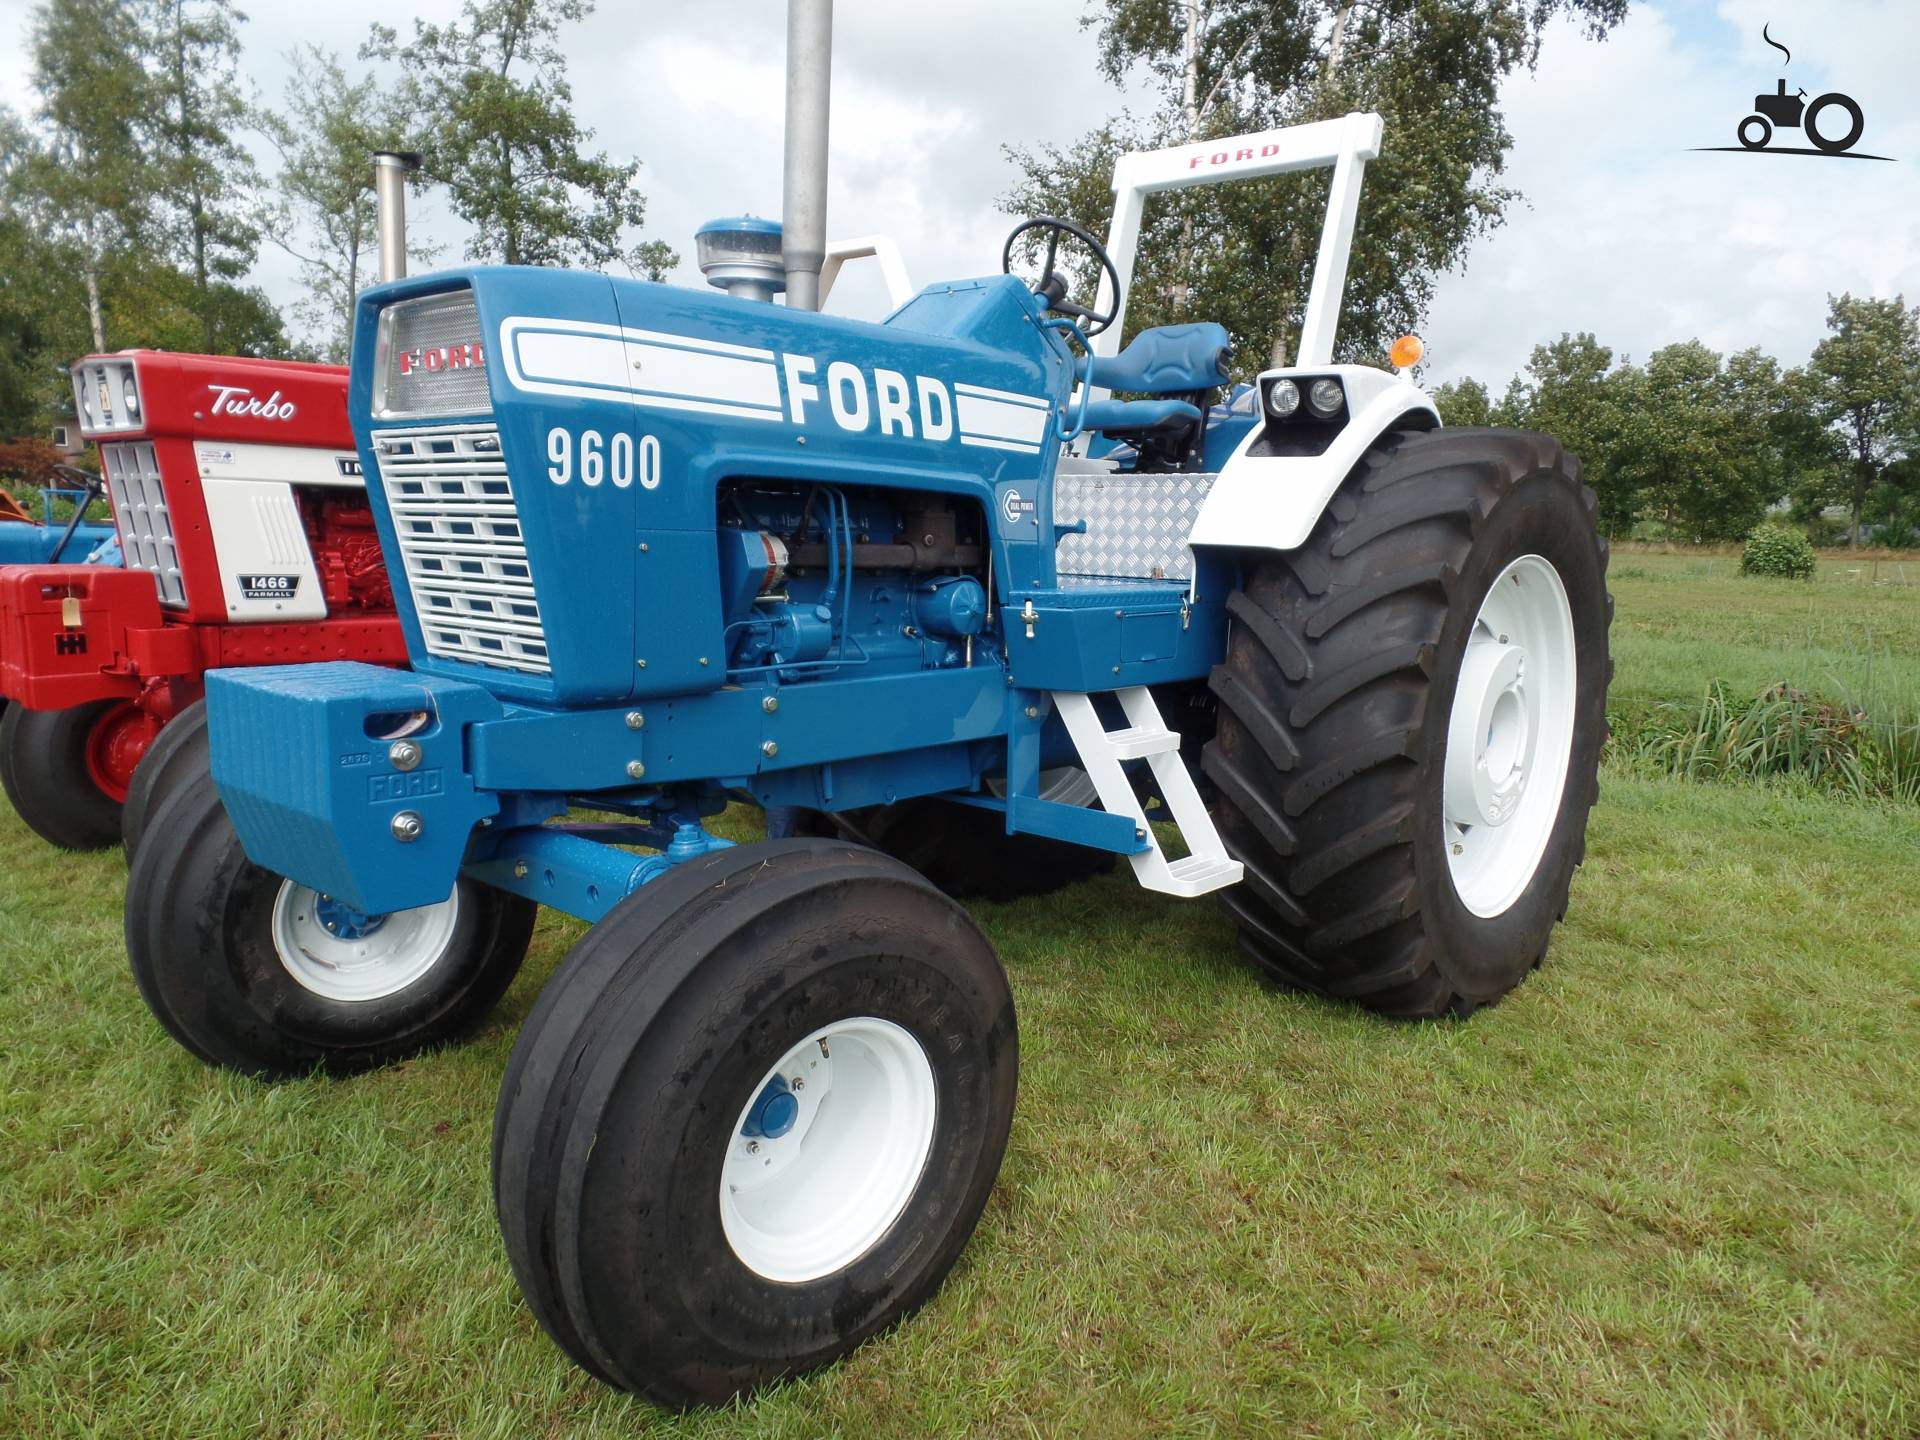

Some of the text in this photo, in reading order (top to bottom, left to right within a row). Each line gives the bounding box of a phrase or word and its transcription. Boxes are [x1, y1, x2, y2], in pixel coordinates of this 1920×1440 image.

[1189, 144, 1280, 169] FORD
[207, 384, 295, 419] Turbo
[782, 352, 953, 441] FORD
[547, 427, 660, 489] 9600
[1010, 502, 1034, 511] DUAL POWER
[251, 577, 288, 589] 1466
[368, 768, 442, 802] FORD
